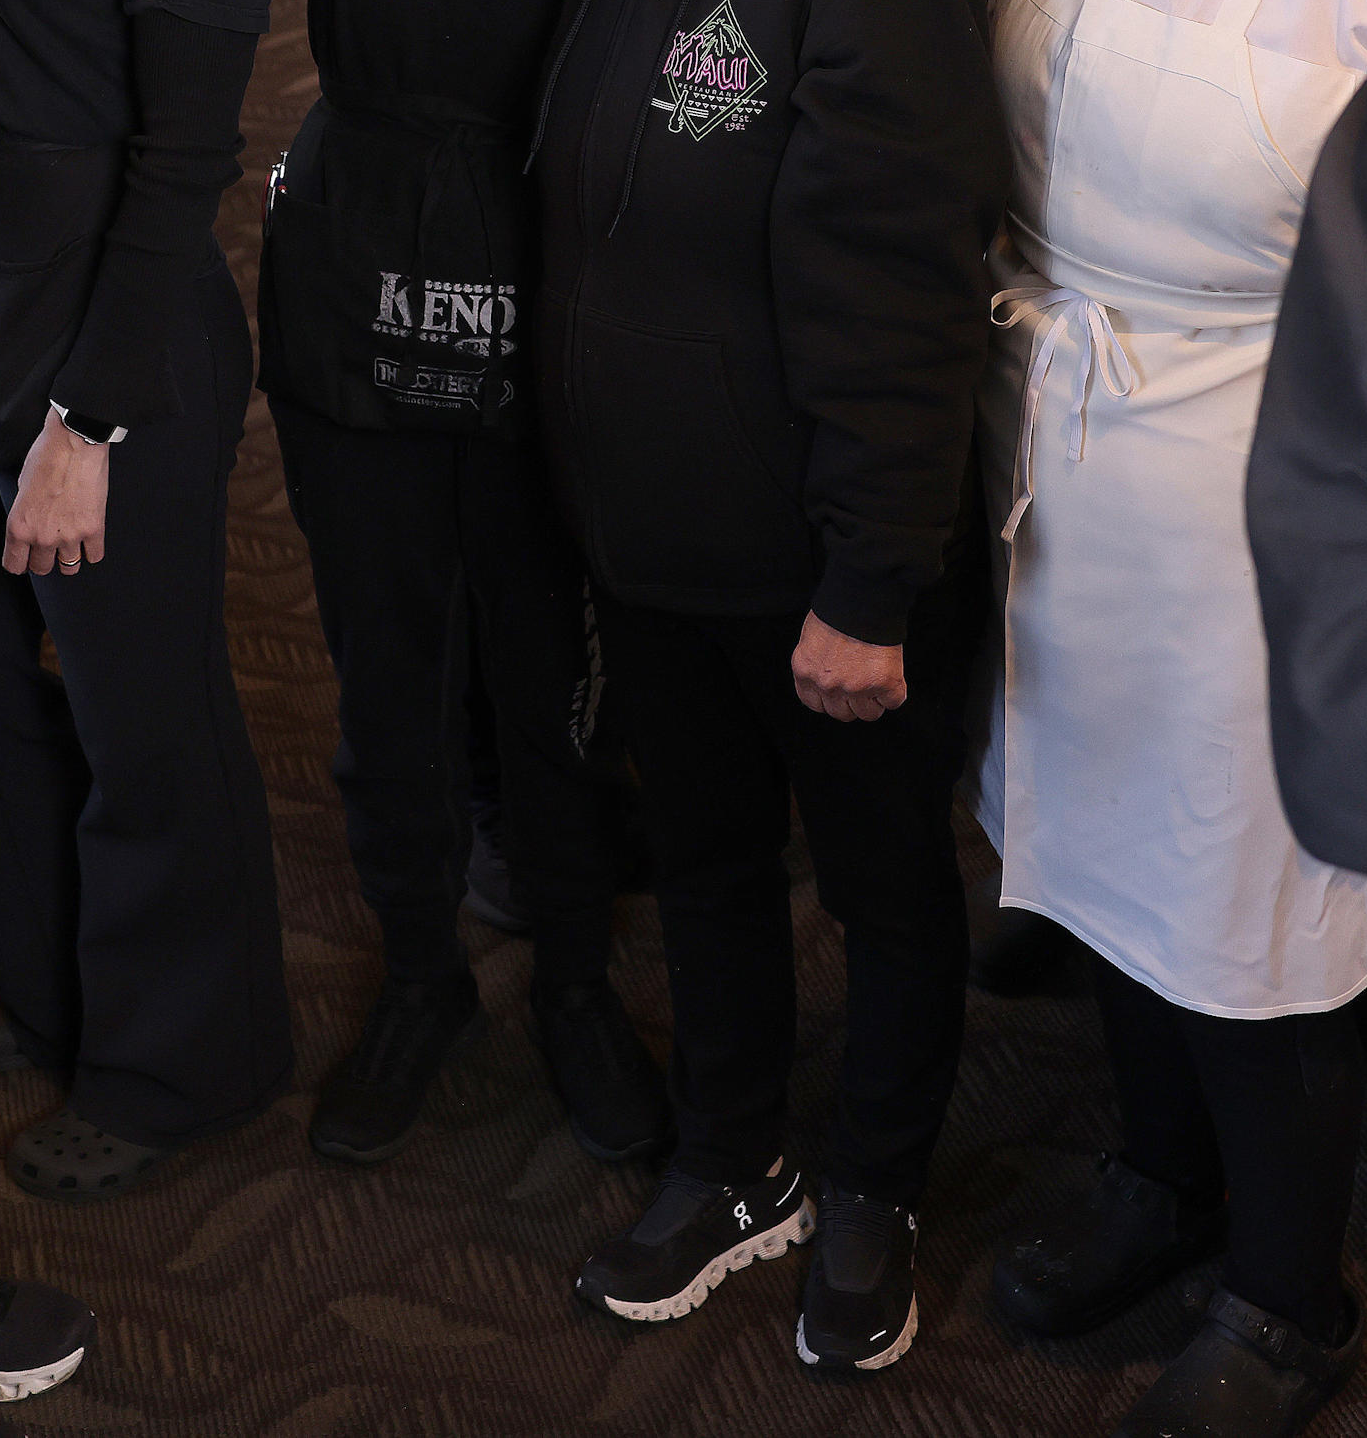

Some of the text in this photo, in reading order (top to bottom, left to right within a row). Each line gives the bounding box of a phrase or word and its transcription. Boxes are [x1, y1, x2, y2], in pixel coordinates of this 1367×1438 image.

[662, 30, 749, 91] MAUI
[677, 82, 739, 98] RESTAURANT
[376, 270, 516, 335] KENO
